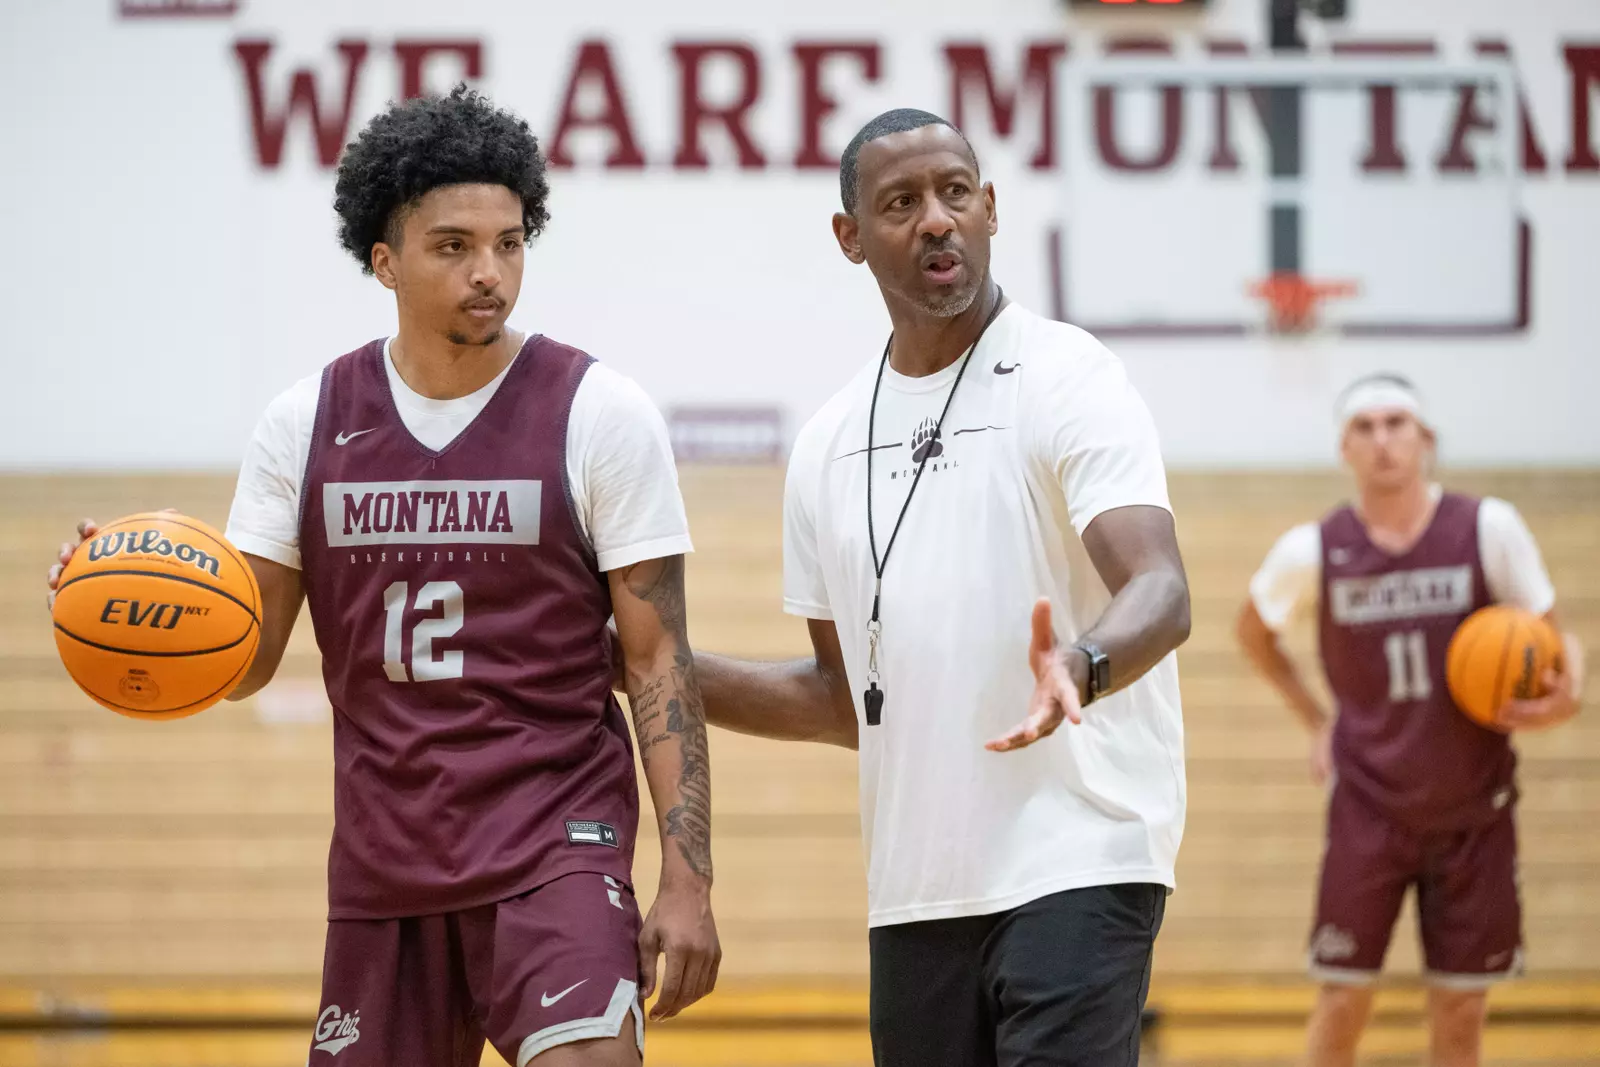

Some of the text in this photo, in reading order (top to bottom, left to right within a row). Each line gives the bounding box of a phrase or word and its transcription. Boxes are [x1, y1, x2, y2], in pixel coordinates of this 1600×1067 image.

[549, 40, 882, 169] ARE
[342, 490, 514, 535] MONTANA
[88, 529, 221, 579] Wilson
[350, 552, 506, 564] BASKETBALL
[100, 598, 211, 630] EVO NXT
[383, 580, 464, 682] 12
[1384, 631, 1432, 702] 11
[604, 830, 614, 841] M
